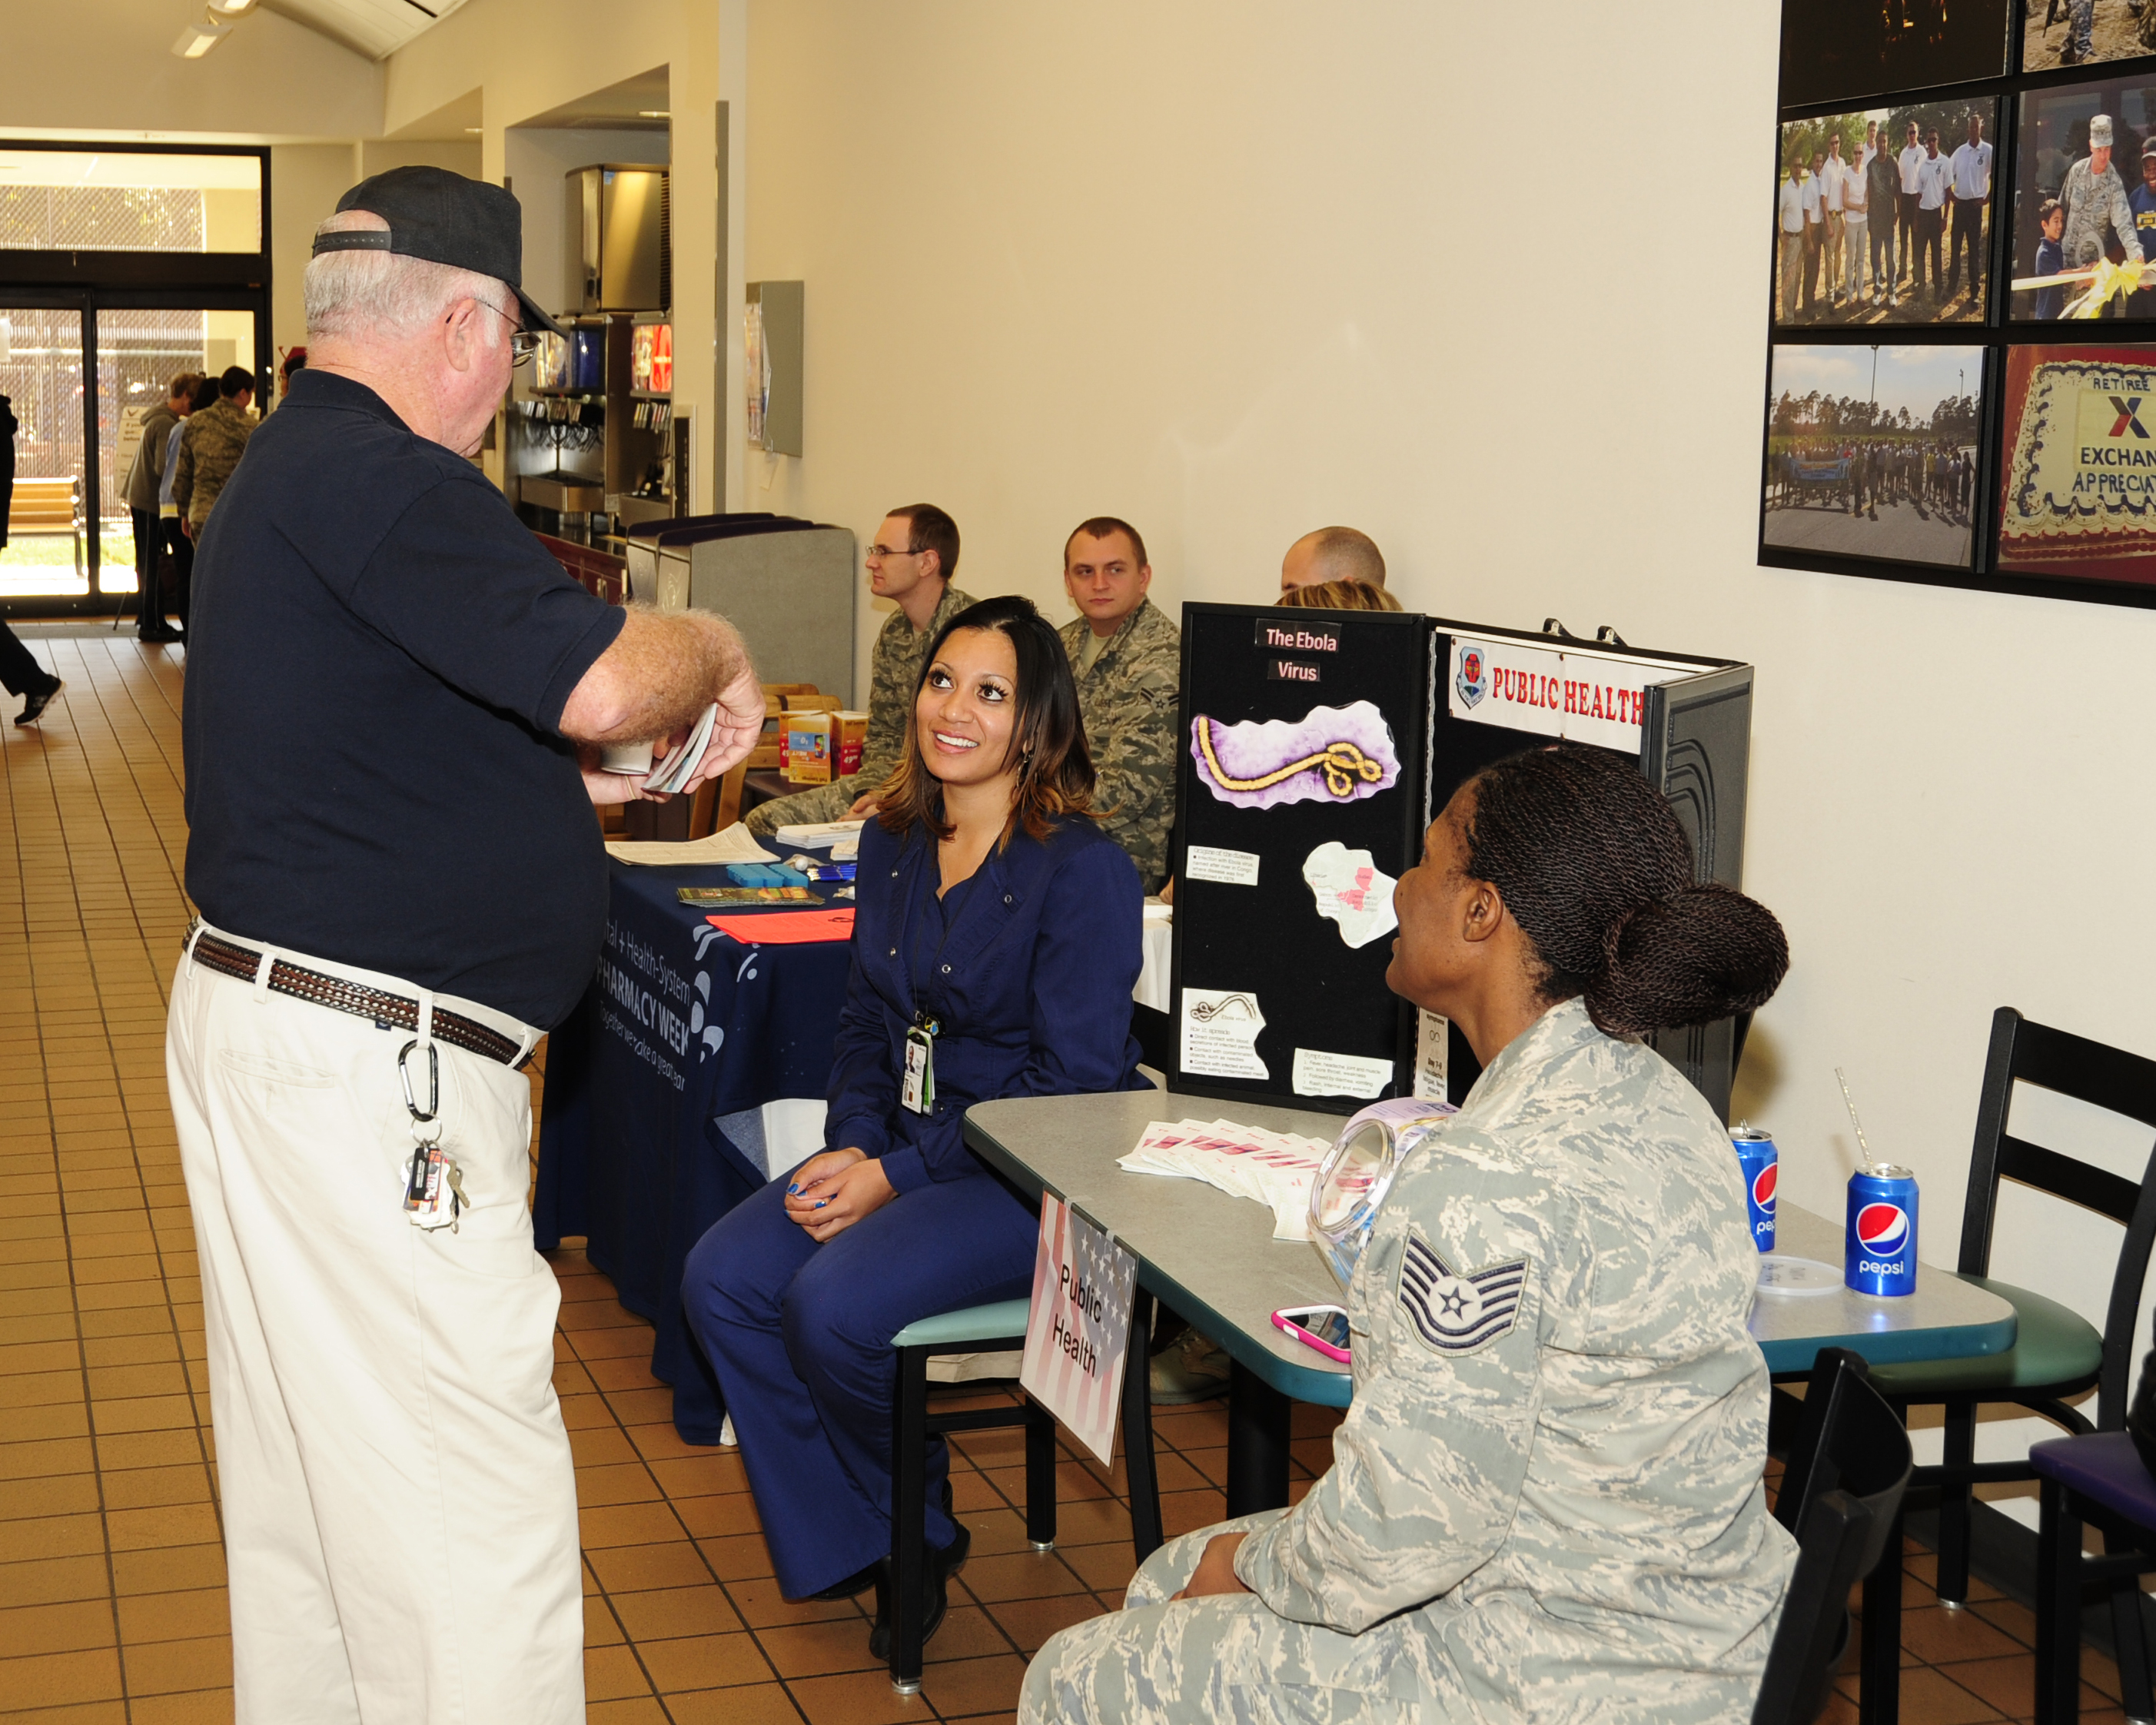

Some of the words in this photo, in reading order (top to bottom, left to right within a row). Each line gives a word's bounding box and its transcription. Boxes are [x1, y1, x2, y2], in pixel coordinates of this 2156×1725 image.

[2094, 377, 2151, 391] RETIREE
[1267, 629, 1294, 646] The
[1296, 631, 1337, 651] Ebola
[1278, 661, 1317, 681] Virus
[1493, 667, 1559, 710] PUBLIC
[1564, 680, 1645, 726] HEALTH
[627, 931, 690, 1007] Health-System
[596, 955, 657, 1029] PHARMACY
[658, 1002, 690, 1057] WEEK
[1060, 1264, 1102, 1324] Public
[1859, 1260, 1905, 1277] pepsi
[1052, 1313, 1097, 1378] Health
